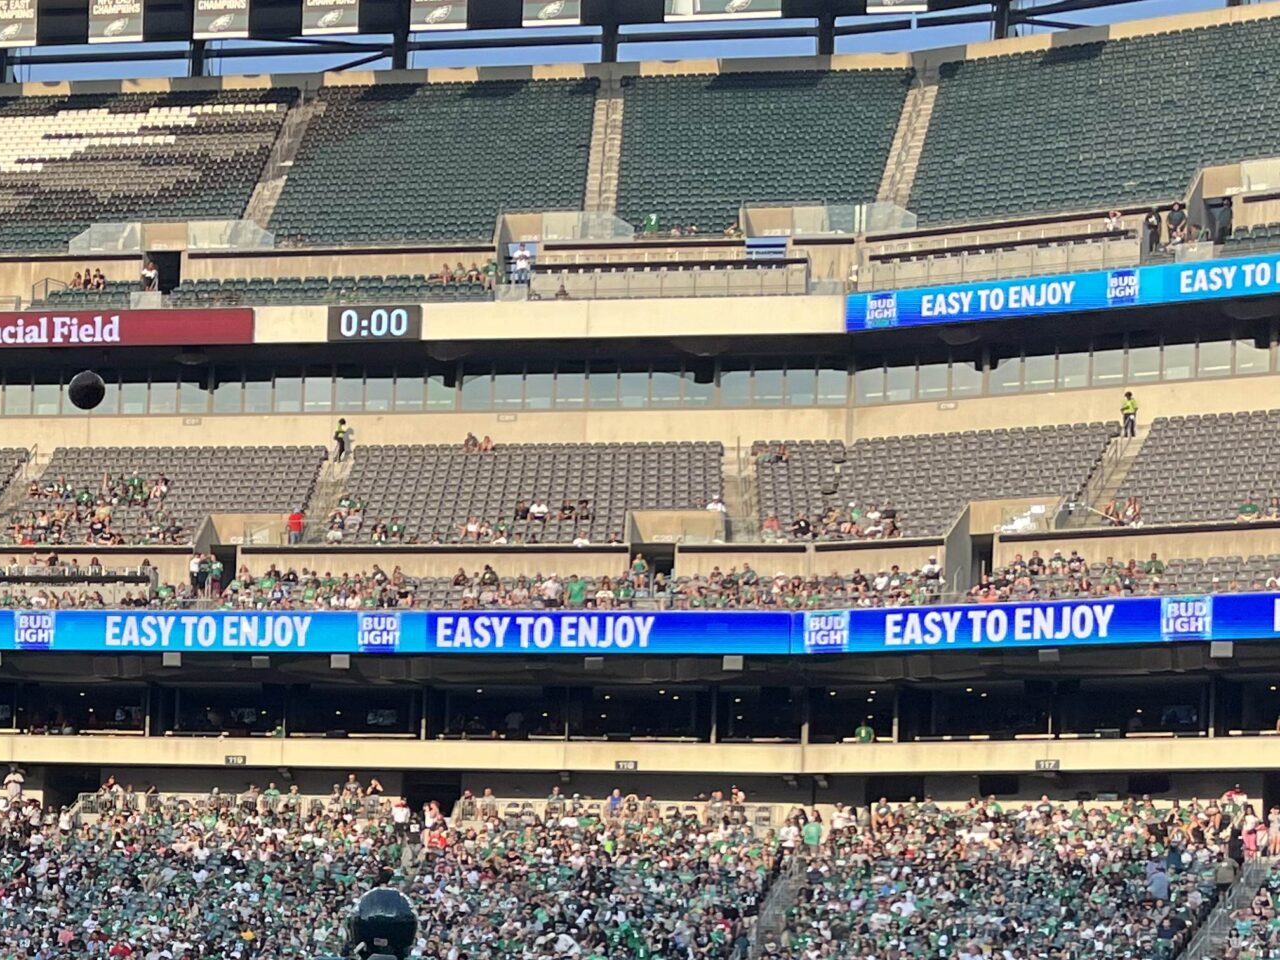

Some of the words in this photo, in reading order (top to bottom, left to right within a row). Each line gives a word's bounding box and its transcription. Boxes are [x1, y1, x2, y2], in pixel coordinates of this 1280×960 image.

[93, 4, 140, 15] CHAMPIONS
[198, 0, 246, 10] CHAMPIONS
[1110, 276, 1136, 288] BUD
[1180, 266, 1237, 294] EASY
[1241, 262, 1271, 287] TO
[921, 291, 971, 317] EASY
[977, 288, 1005, 311] TO
[1009, 281, 1076, 309] ENJOY
[1107, 285, 1138, 298] LIGHT
[869, 298, 894, 309] BUD
[51, 315, 120, 344] Field
[340, 309, 407, 338] 0:00
[1167, 602, 1206, 617] BUD
[19, 615, 51, 629] BUD
[362, 616, 396, 630] BUD
[810, 616, 845, 631] BUD
[886, 612, 959, 645] EASY
[967, 610, 1008, 642] TO
[1014, 604, 1114, 640] ENJOY
[1161, 615, 1211, 634] LIGHT
[14, 629, 54, 644] LIGHT
[106, 616, 176, 646] EASY
[180, 616, 216, 647] TO
[223, 616, 311, 647] ENJOY
[358, 630, 399, 645] LIGHT
[436, 617, 511, 647] EASY
[516, 617, 554, 647] TO
[560, 616, 655, 647] ENJOY
[805, 630, 849, 646] LIGHT
[1039, 761, 1056, 769] 117
